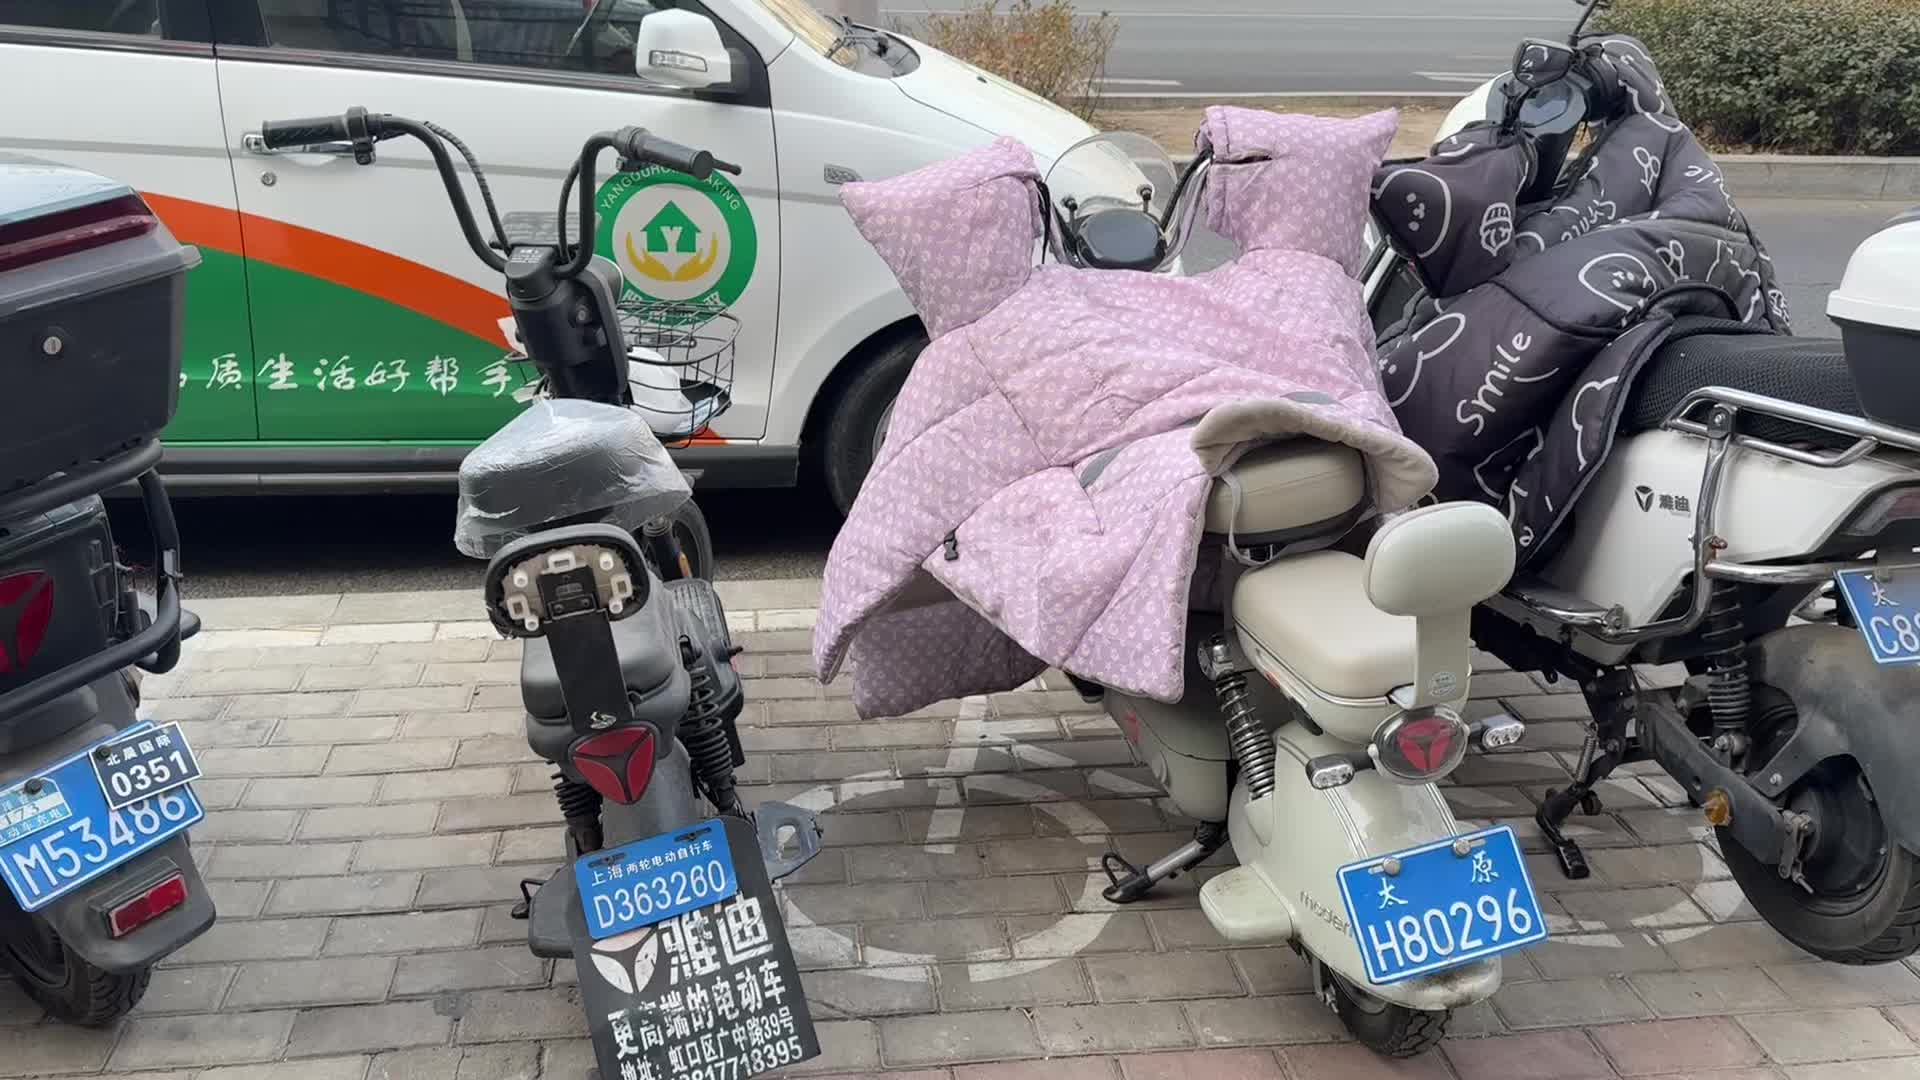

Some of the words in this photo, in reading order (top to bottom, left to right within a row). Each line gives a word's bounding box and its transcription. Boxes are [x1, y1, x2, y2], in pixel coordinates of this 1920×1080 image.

[179, 351, 513, 398] 质生活好帮手
[1456, 331, 1532, 436] Smile
[111, 750, 188, 797] 0351
[12, 792, 186, 897] M53486
[1377, 850, 1499, 910] 太原
[593, 859, 727, 929] D363260
[1368, 887, 1533, 973] H80296
[658, 891, 774, 985] 雅迪
[608, 959, 786, 1059] 更高端的电动车
